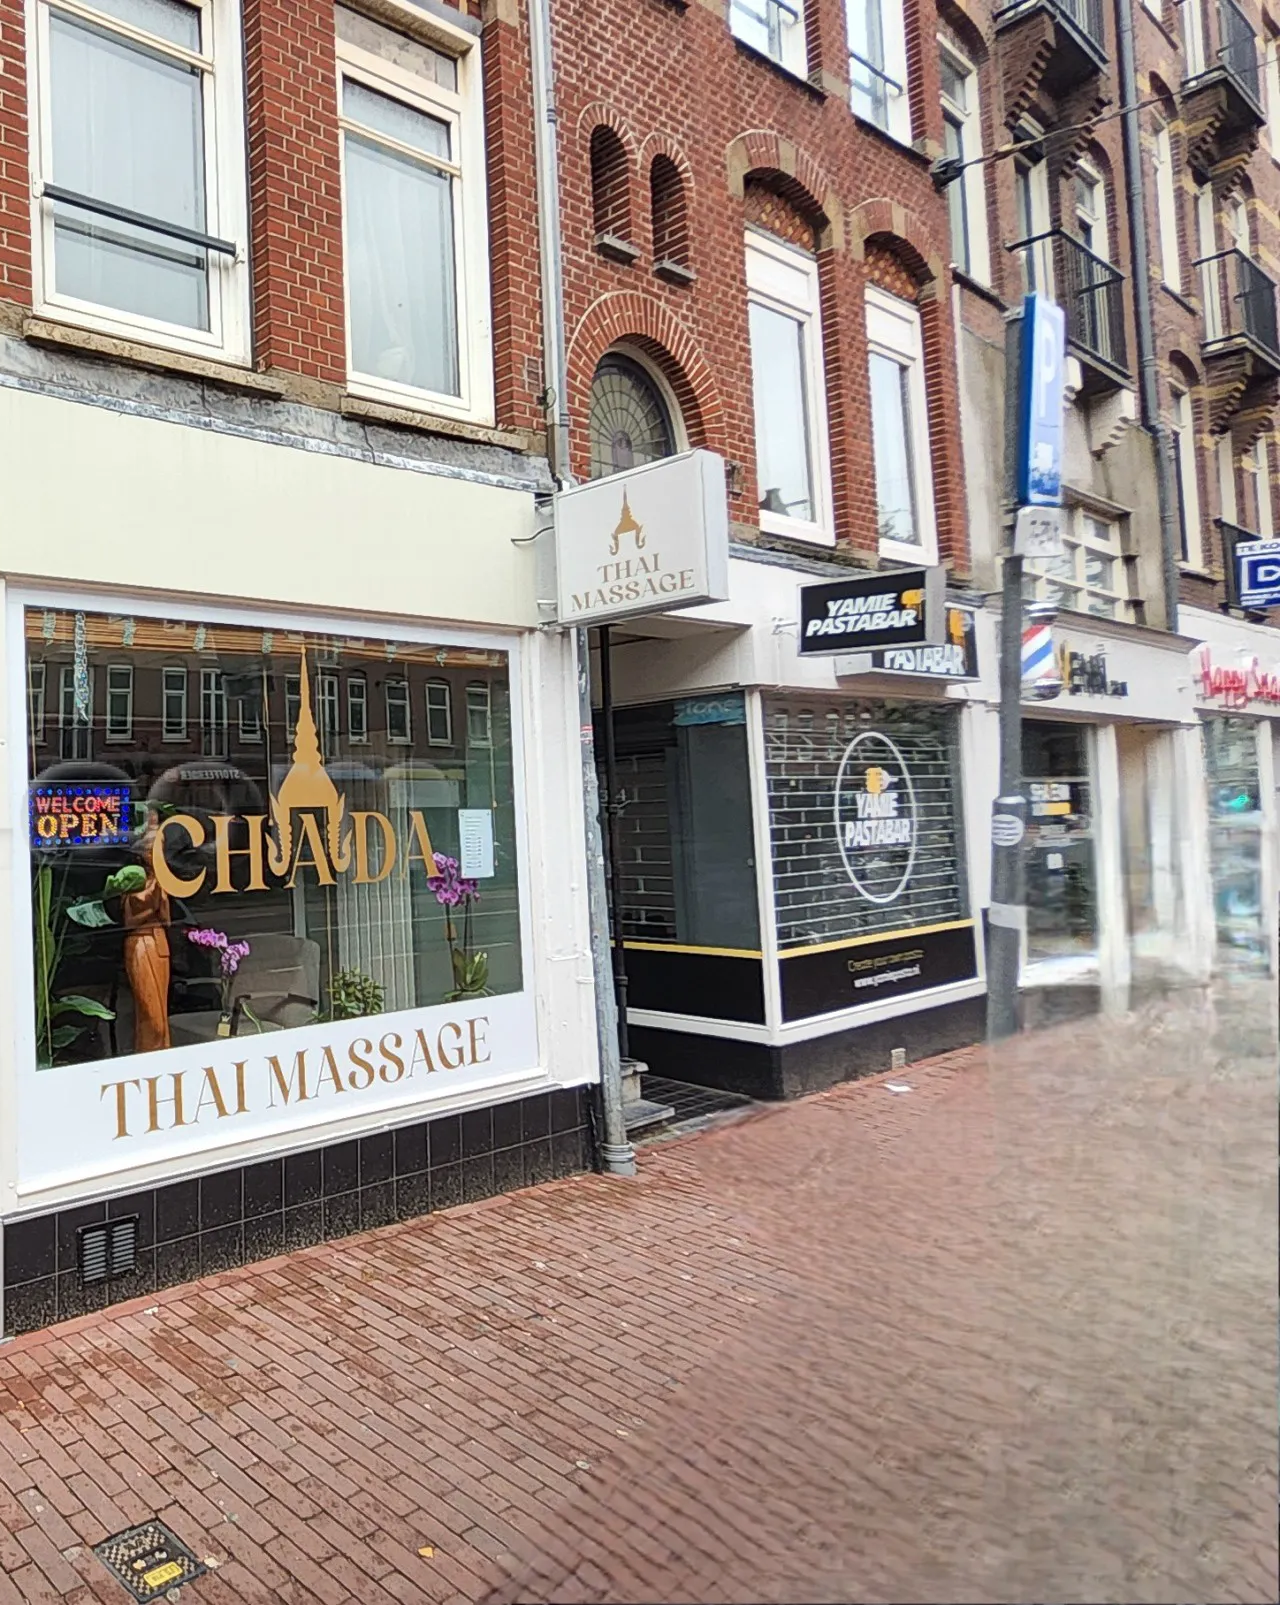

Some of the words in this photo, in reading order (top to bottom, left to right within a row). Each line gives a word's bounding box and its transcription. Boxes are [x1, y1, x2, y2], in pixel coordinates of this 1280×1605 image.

[597, 552, 662, 584] THAI
[571, 568, 696, 613] MASSAGE
[827, 592, 898, 617] YAMIE
[805, 609, 918, 638] PASTABAR
[35, 797, 121, 813] WELCOME
[855, 792, 899, 818] YAMIE
[37, 813, 121, 839] OPEN
[844, 818, 912, 848] PASTABAR
[152, 809, 445, 899] CHADA
[100, 1060, 250, 1141] THAI
[266, 1016, 493, 1110] MASSAGE
